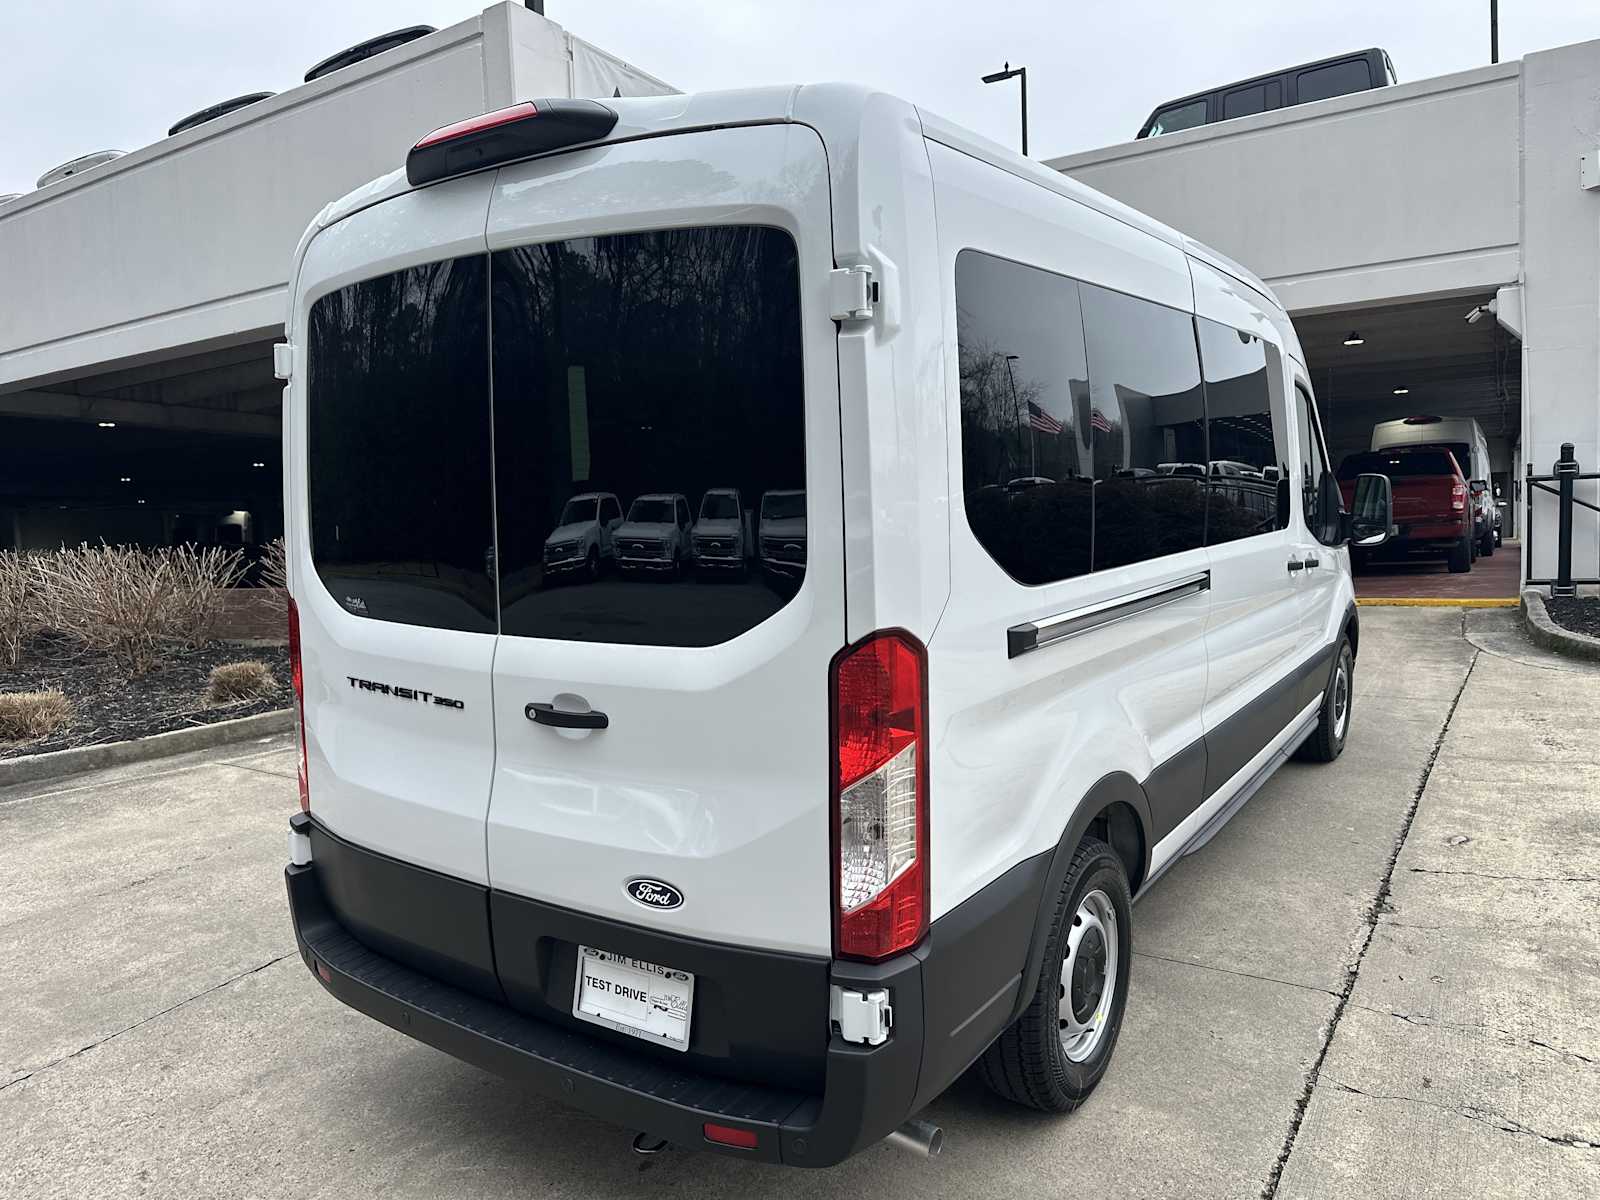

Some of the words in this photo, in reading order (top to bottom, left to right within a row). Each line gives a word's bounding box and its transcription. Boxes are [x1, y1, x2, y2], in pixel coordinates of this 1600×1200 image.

[346, 676, 433, 703] TRANSIT
[636, 883, 671, 905] Ford
[607, 952, 626, 965] JIM
[631, 959, 665, 975] ELLIS
[585, 975, 612, 992] TEST
[615, 984, 647, 1003] DRIVE
